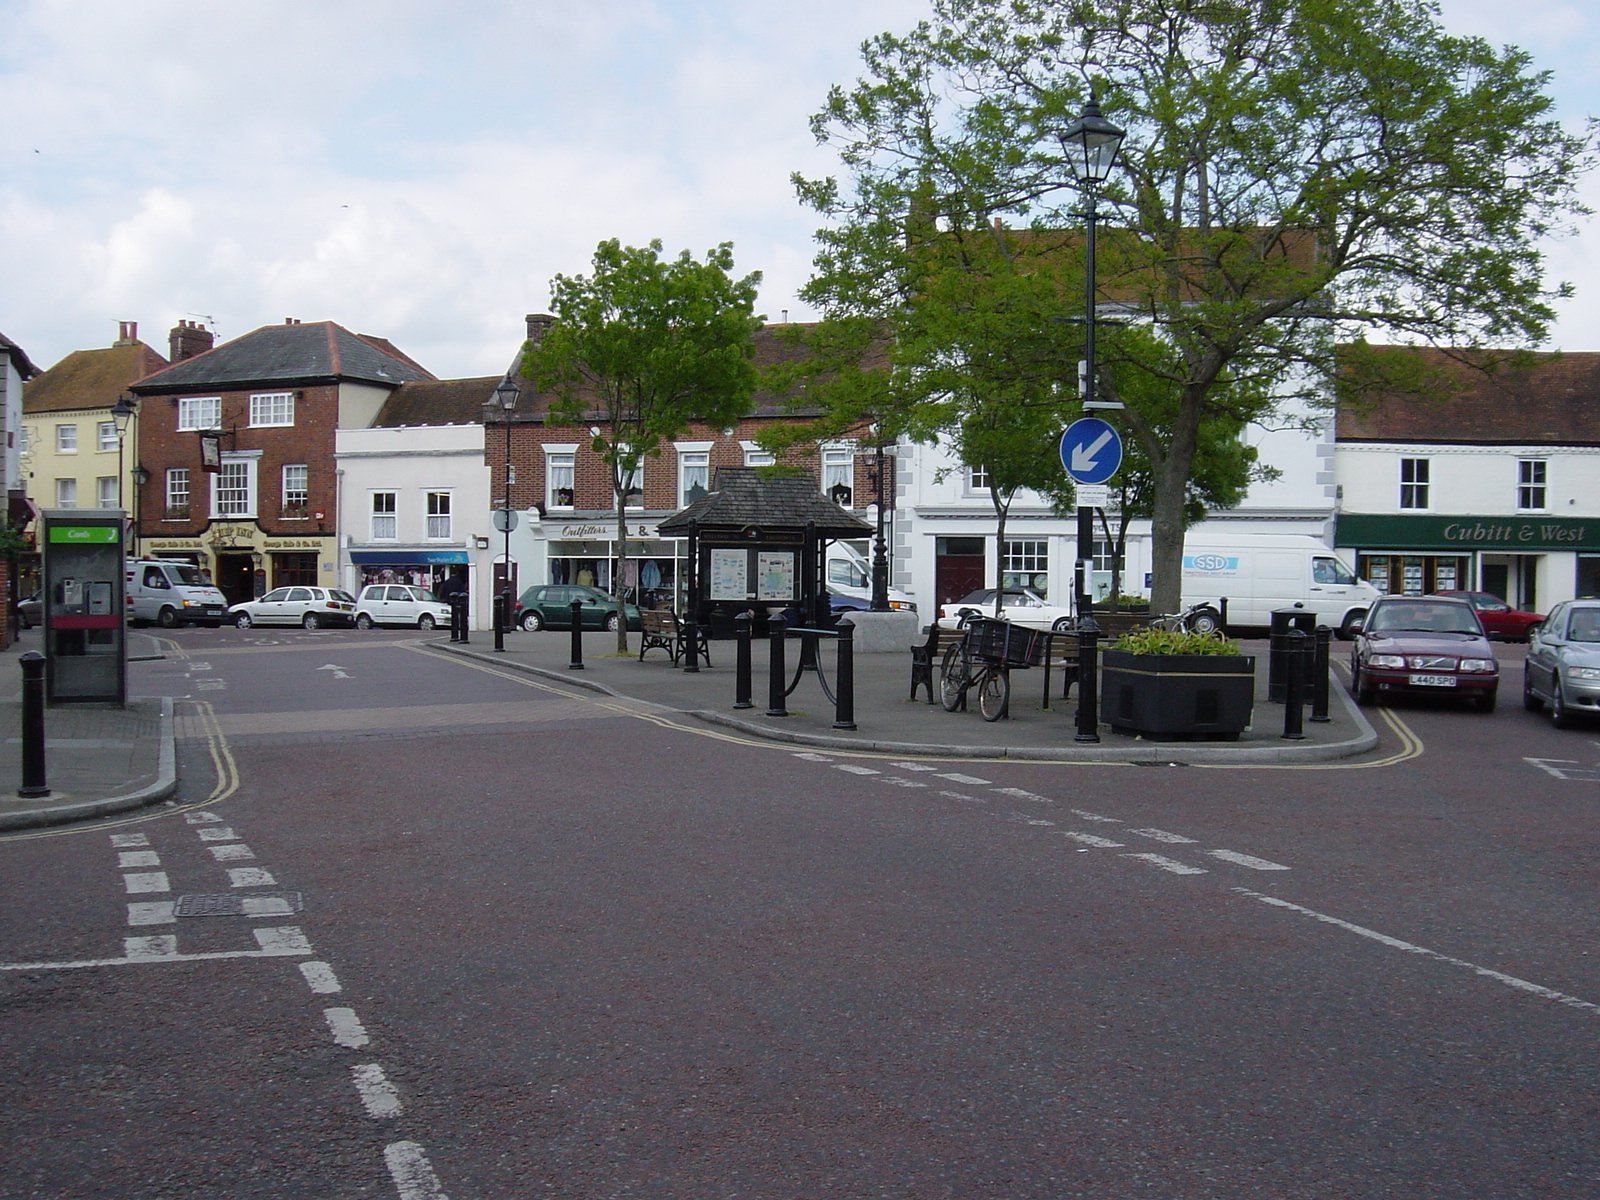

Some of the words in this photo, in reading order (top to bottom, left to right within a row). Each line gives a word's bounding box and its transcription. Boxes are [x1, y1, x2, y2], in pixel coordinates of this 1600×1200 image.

[638, 525, 650, 537] &
[1444, 523, 1512, 541] Cubitt
[1518, 525, 1534, 542] &
[1541, 525, 1585, 541] West
[1196, 556, 1225, 569] SSD
